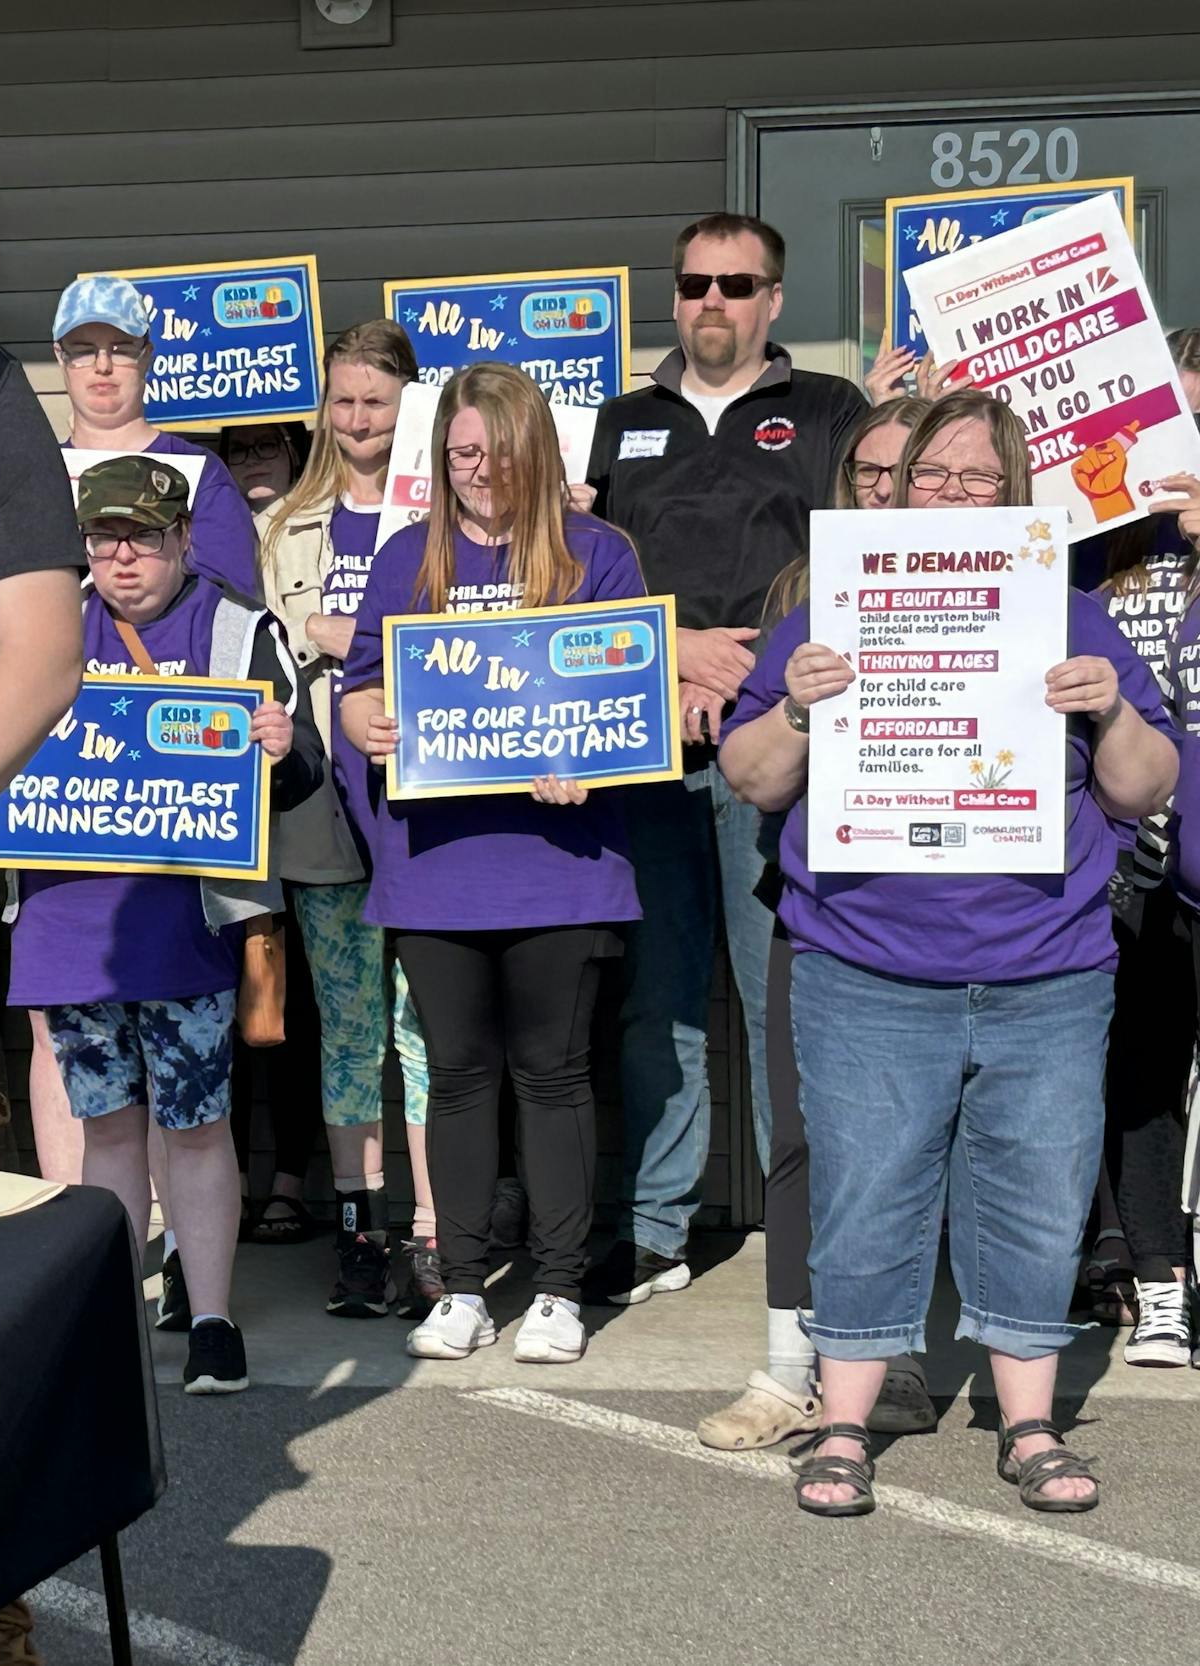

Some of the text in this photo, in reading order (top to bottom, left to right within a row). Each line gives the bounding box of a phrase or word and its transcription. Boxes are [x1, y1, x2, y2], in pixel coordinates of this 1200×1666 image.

[930, 127, 1079, 188] 8520
[945, 294, 956, 307] A
[955, 287, 980, 303] Day
[981, 266, 1031, 293] Without
[1036, 253, 1070, 271] Child
[161, 308, 199, 342] In
[418, 301, 504, 351] All In
[954, 327, 967, 352] I
[972, 298, 1050, 345] WORK
[1056, 283, 1086, 314] IN
[153, 342, 298, 376] OUR LITTLEST
[967, 304, 1120, 384] CHILDCARE
[143, 366, 301, 405] NNESOTANS
[987, 359, 1076, 406] O YOU
[1056, 390, 1091, 421] GO
[1098, 373, 1136, 404] TO
[1030, 431, 1087, 470] ORK.
[862, 550, 1013, 575] WE DEMAND:
[448, 583, 525, 601] HILDRE
[861, 590, 988, 608] AN EQUITABLE
[1108, 592, 1186, 617] FUTU
[859, 610, 1000, 626] child care system built
[859, 623, 986, 637] on racial and gender
[1118, 619, 1163, 638] AND
[562, 631, 603, 648] KIDS
[859, 635, 905, 648] justice.
[424, 637, 530, 692] All In
[861, 654, 995, 670] THRIVING WAGES
[859, 694, 942, 710] providers.
[860, 678, 966, 692] for child care
[417, 693, 646, 732] FOR OUR LITTLEST
[863, 721, 970, 736] AFFORDABLE
[78, 722, 126, 763] In
[417, 720, 649, 764] MINNESOTANS
[859, 744, 983, 758] child care for all
[858, 760, 924, 774] families.
[9, 774, 239, 809] FOR OUR LITTLEST
[853, 794, 1031, 808] A Day Without Child Care
[7, 801, 239, 842] MINNESOTANS
